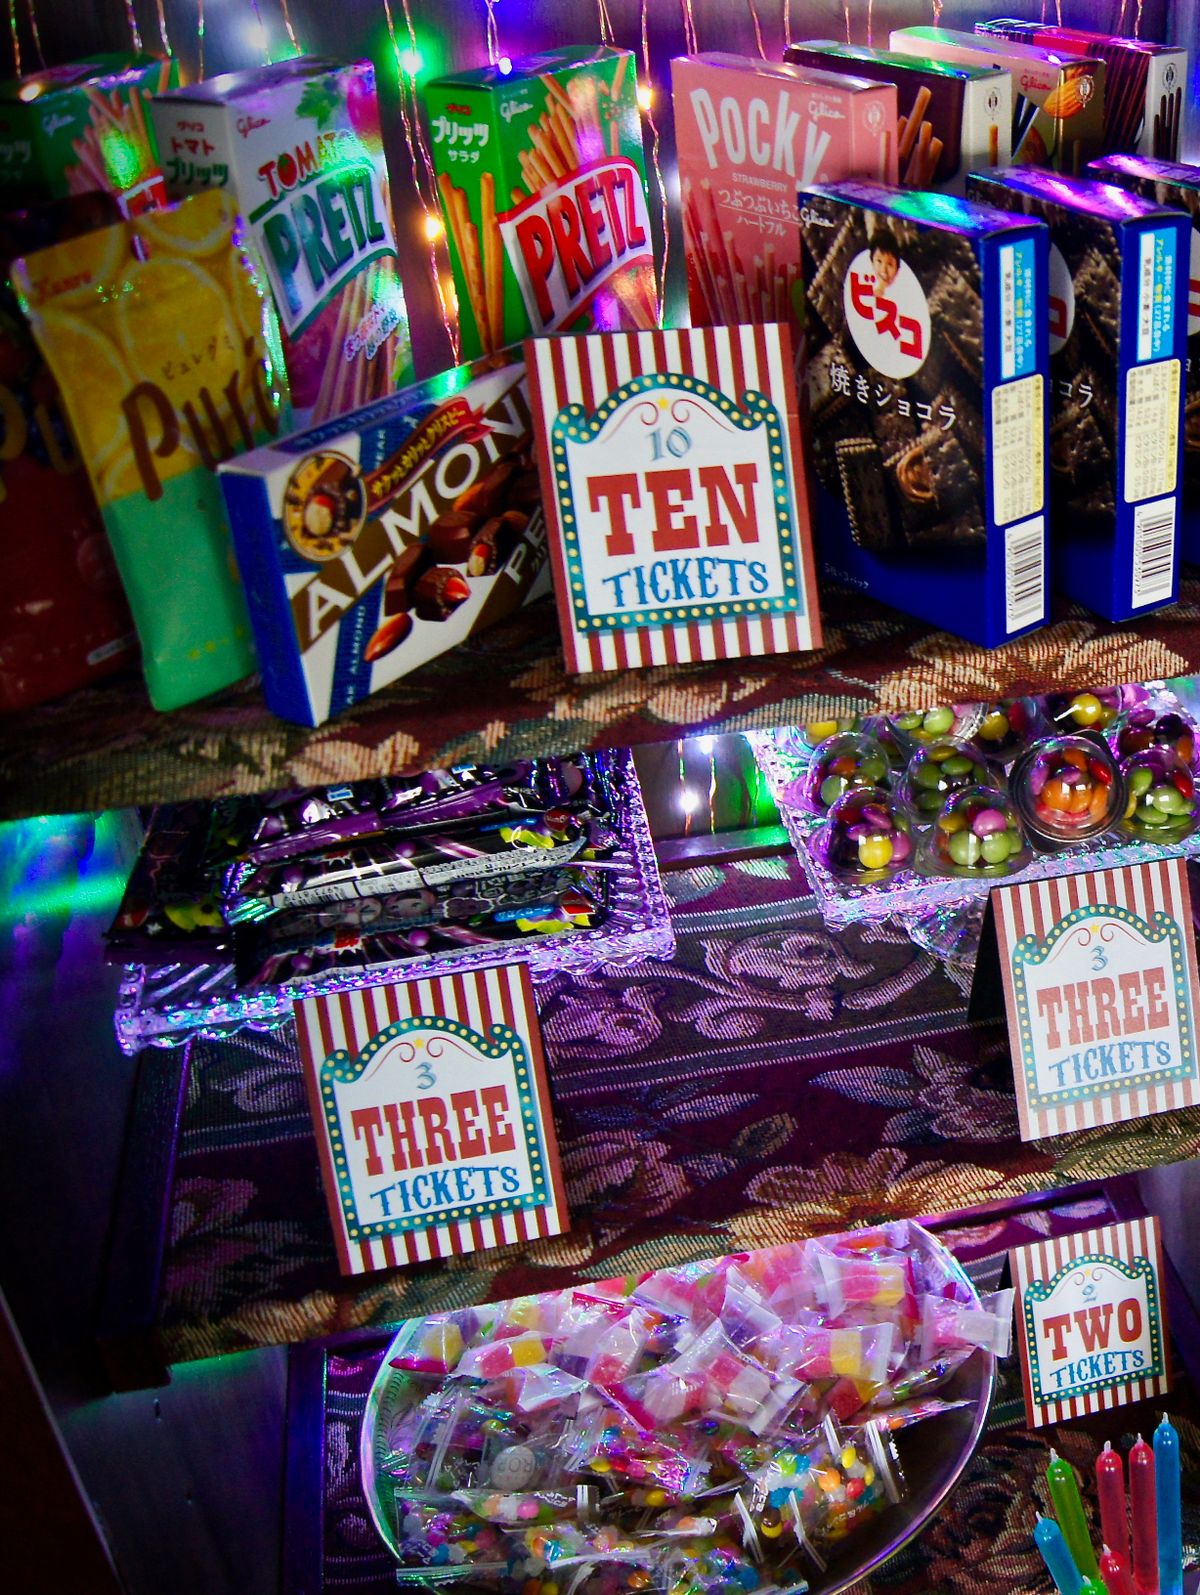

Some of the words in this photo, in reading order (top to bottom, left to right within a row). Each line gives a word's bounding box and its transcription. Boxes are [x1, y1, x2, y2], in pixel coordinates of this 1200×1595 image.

[432, 115, 490, 148] ブリッツ
[808, 101, 846, 120] Glico
[170, 136, 215, 157] トマト
[731, 171, 788, 192] STRAWBERRY
[263, 168, 386, 316] PRETZ
[515, 166, 646, 327] PRETZ
[850, 272, 923, 360] ビスコ
[829, 361, 958, 431] 焼きショコラ
[645, 426, 692, 462] 10
[586, 463, 759, 557] TEN
[602, 556, 770, 608] TICKETS
[1091, 945, 1108, 972] 3
[1036, 966, 1170, 1051] THREE
[415, 1061, 438, 1090] 3
[1048, 1040, 1172, 1088] TICKETS
[350, 1084, 516, 1177] THREE
[369, 1165, 521, 1217] TICKETS
[1042, 1297, 1143, 1361] TWO
[1050, 1349, 1145, 1388] TICKETS
